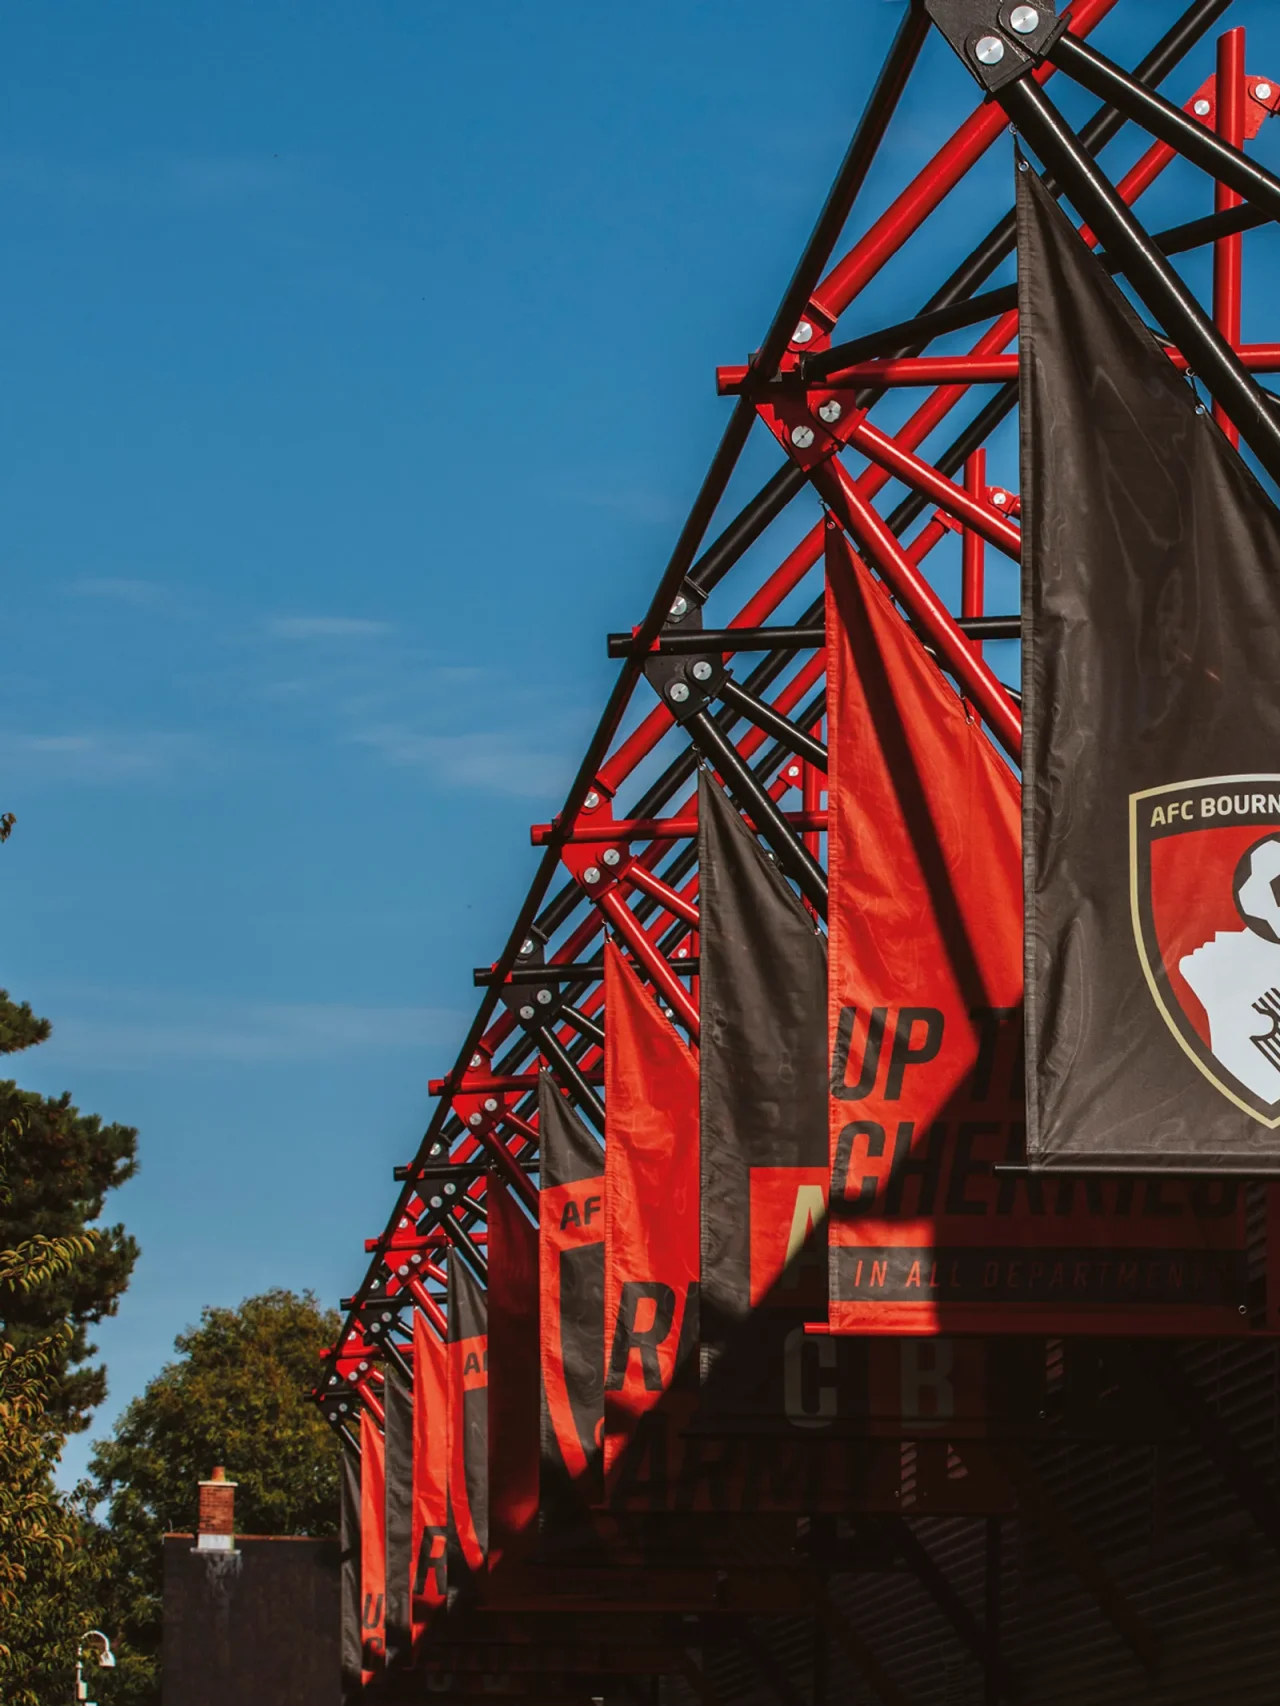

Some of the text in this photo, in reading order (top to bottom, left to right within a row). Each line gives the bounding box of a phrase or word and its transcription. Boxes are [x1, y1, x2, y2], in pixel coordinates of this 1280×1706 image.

[1149, 799, 1194, 828] AFC
[830, 1005, 944, 1102] UP
[559, 1196, 601, 1231] AF
[854, 1260, 888, 1288] IN
[904, 1260, 962, 1288] ALL
